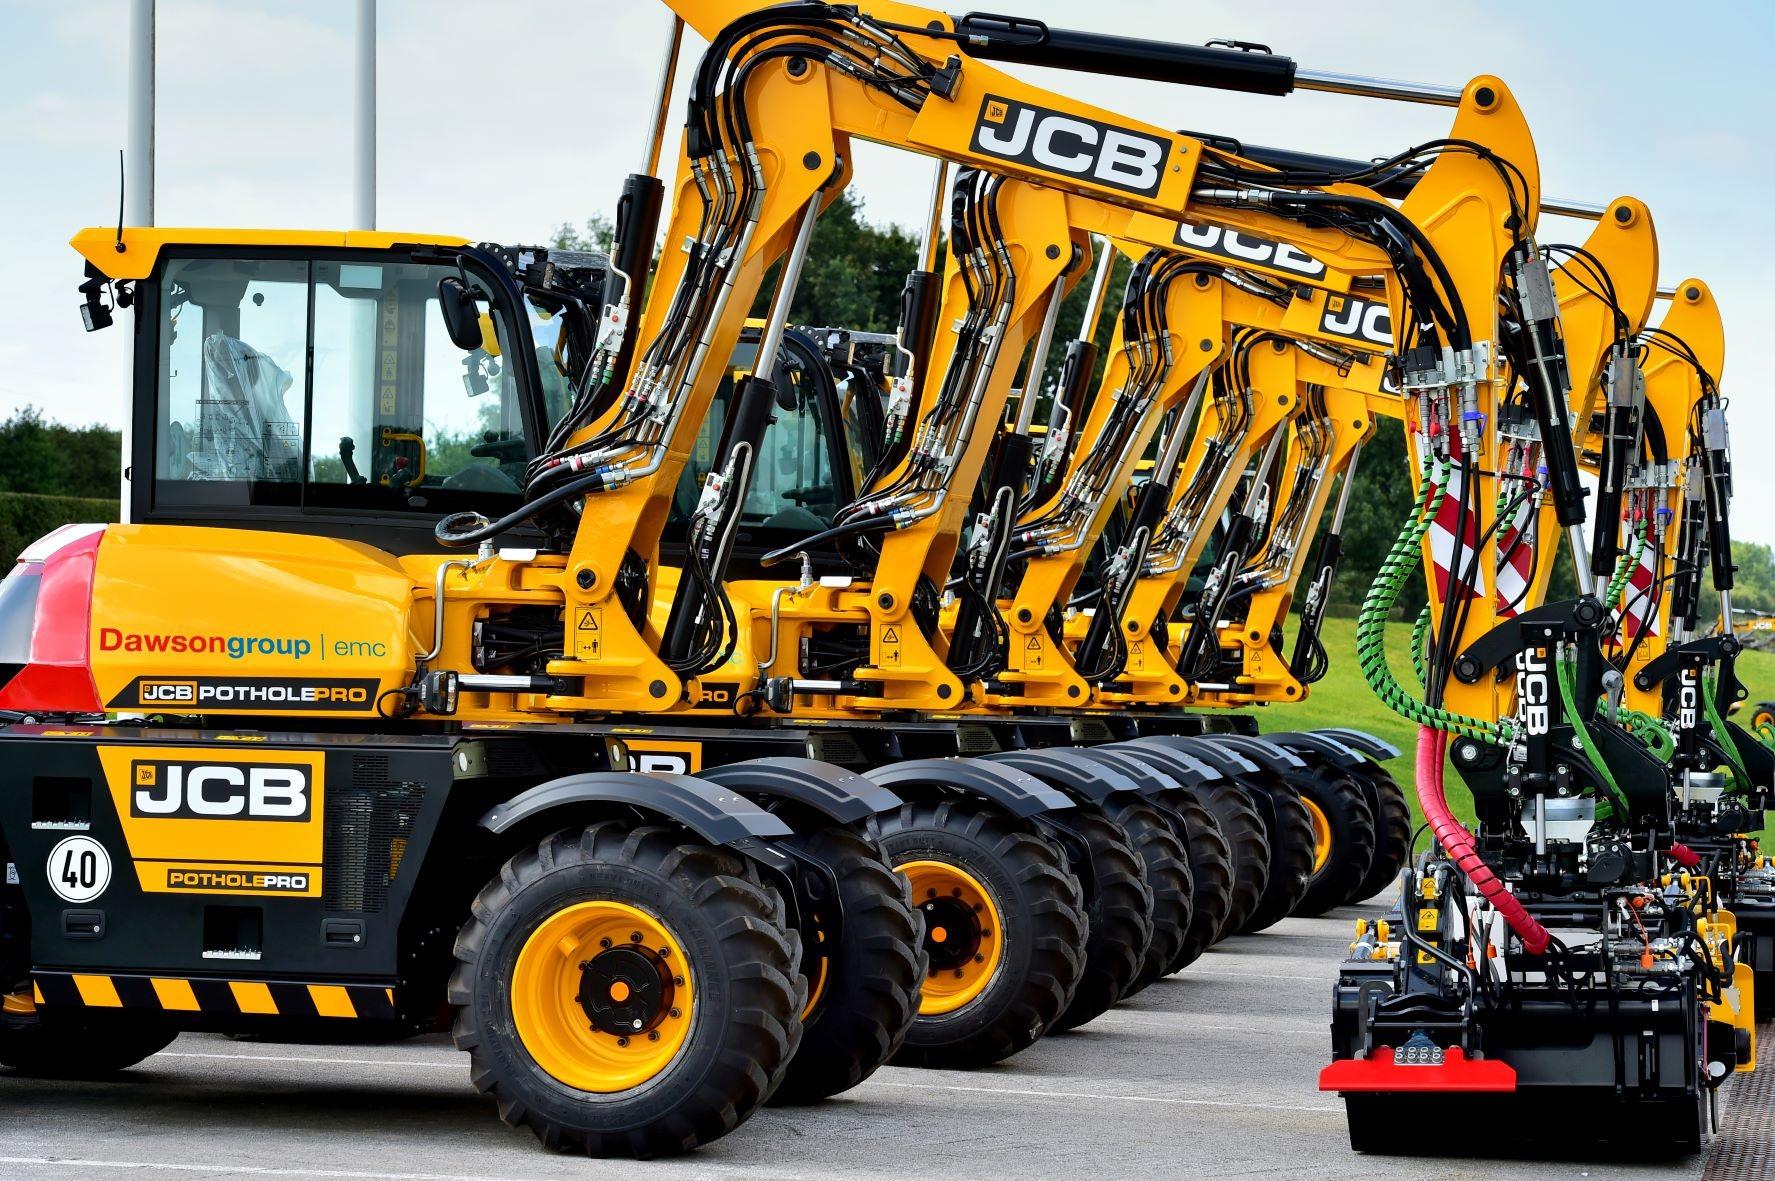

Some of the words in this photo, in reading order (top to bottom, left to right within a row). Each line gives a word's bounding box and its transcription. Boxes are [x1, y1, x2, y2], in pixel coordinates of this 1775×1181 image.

[978, 109, 1163, 190] JCB
[1324, 300, 1394, 345] JC
[100, 627, 311, 660] Dawsongroup
[334, 640, 386, 657] emc
[143, 685, 193, 700] JCB
[1525, 647, 1549, 736] JCB
[1680, 669, 1696, 729] JCB
[135, 765, 307, 817] JCB
[61, 849, 97, 889] 40
